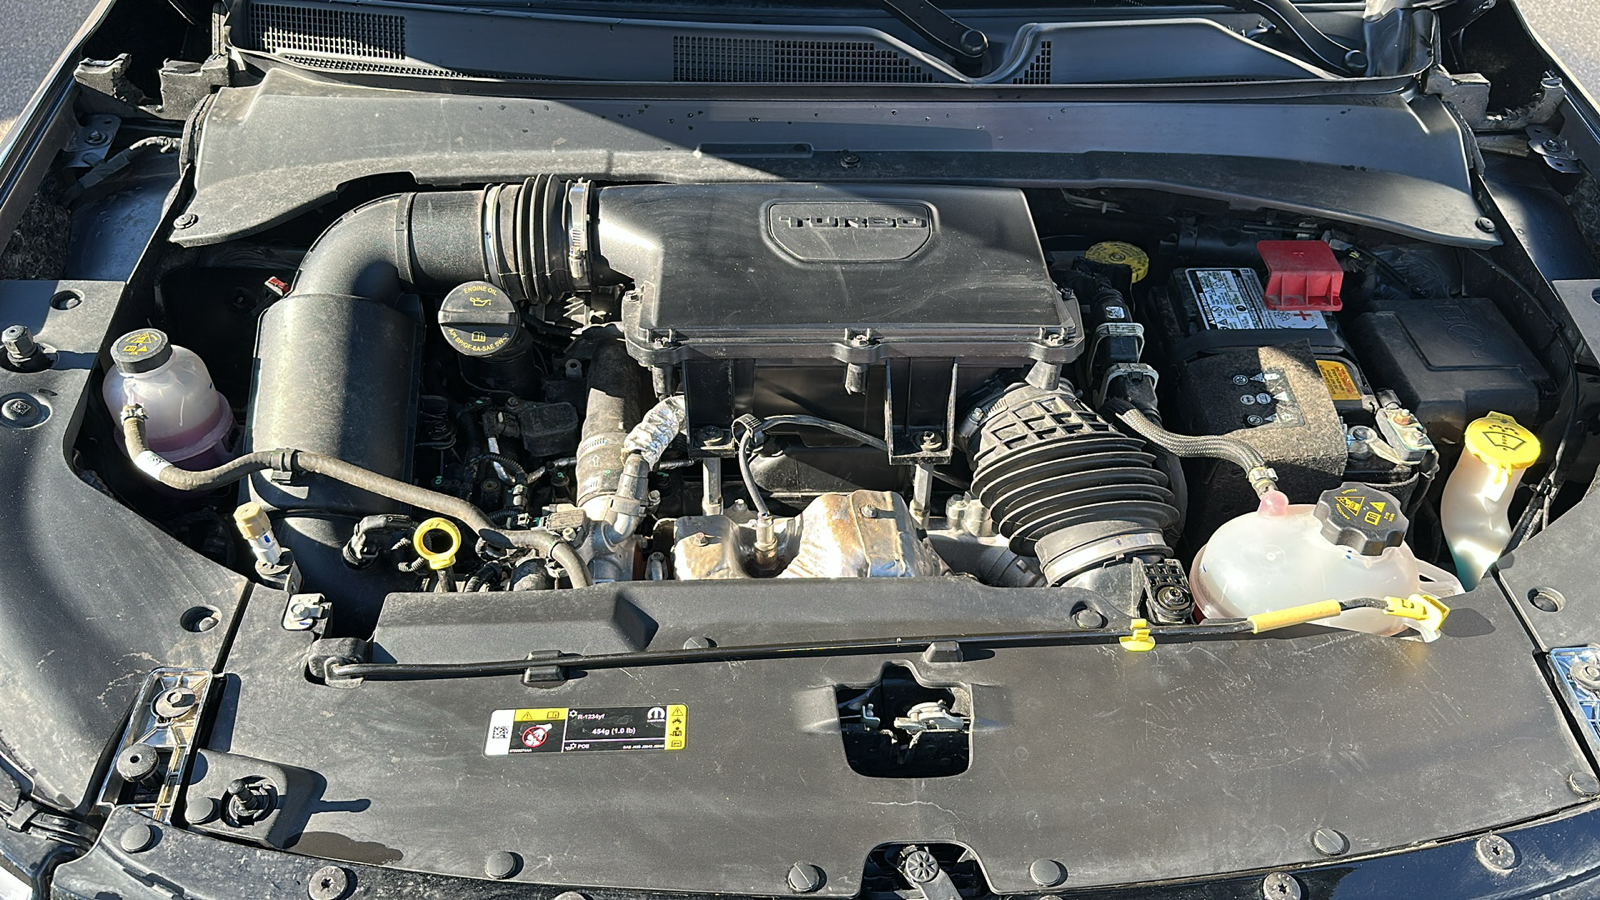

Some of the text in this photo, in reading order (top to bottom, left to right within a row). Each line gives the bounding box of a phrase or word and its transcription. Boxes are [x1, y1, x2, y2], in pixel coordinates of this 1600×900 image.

[779, 216, 926, 229] TURBO
[464, 285, 498, 296] ENGINE OIL
[447, 328, 458, 339] API
